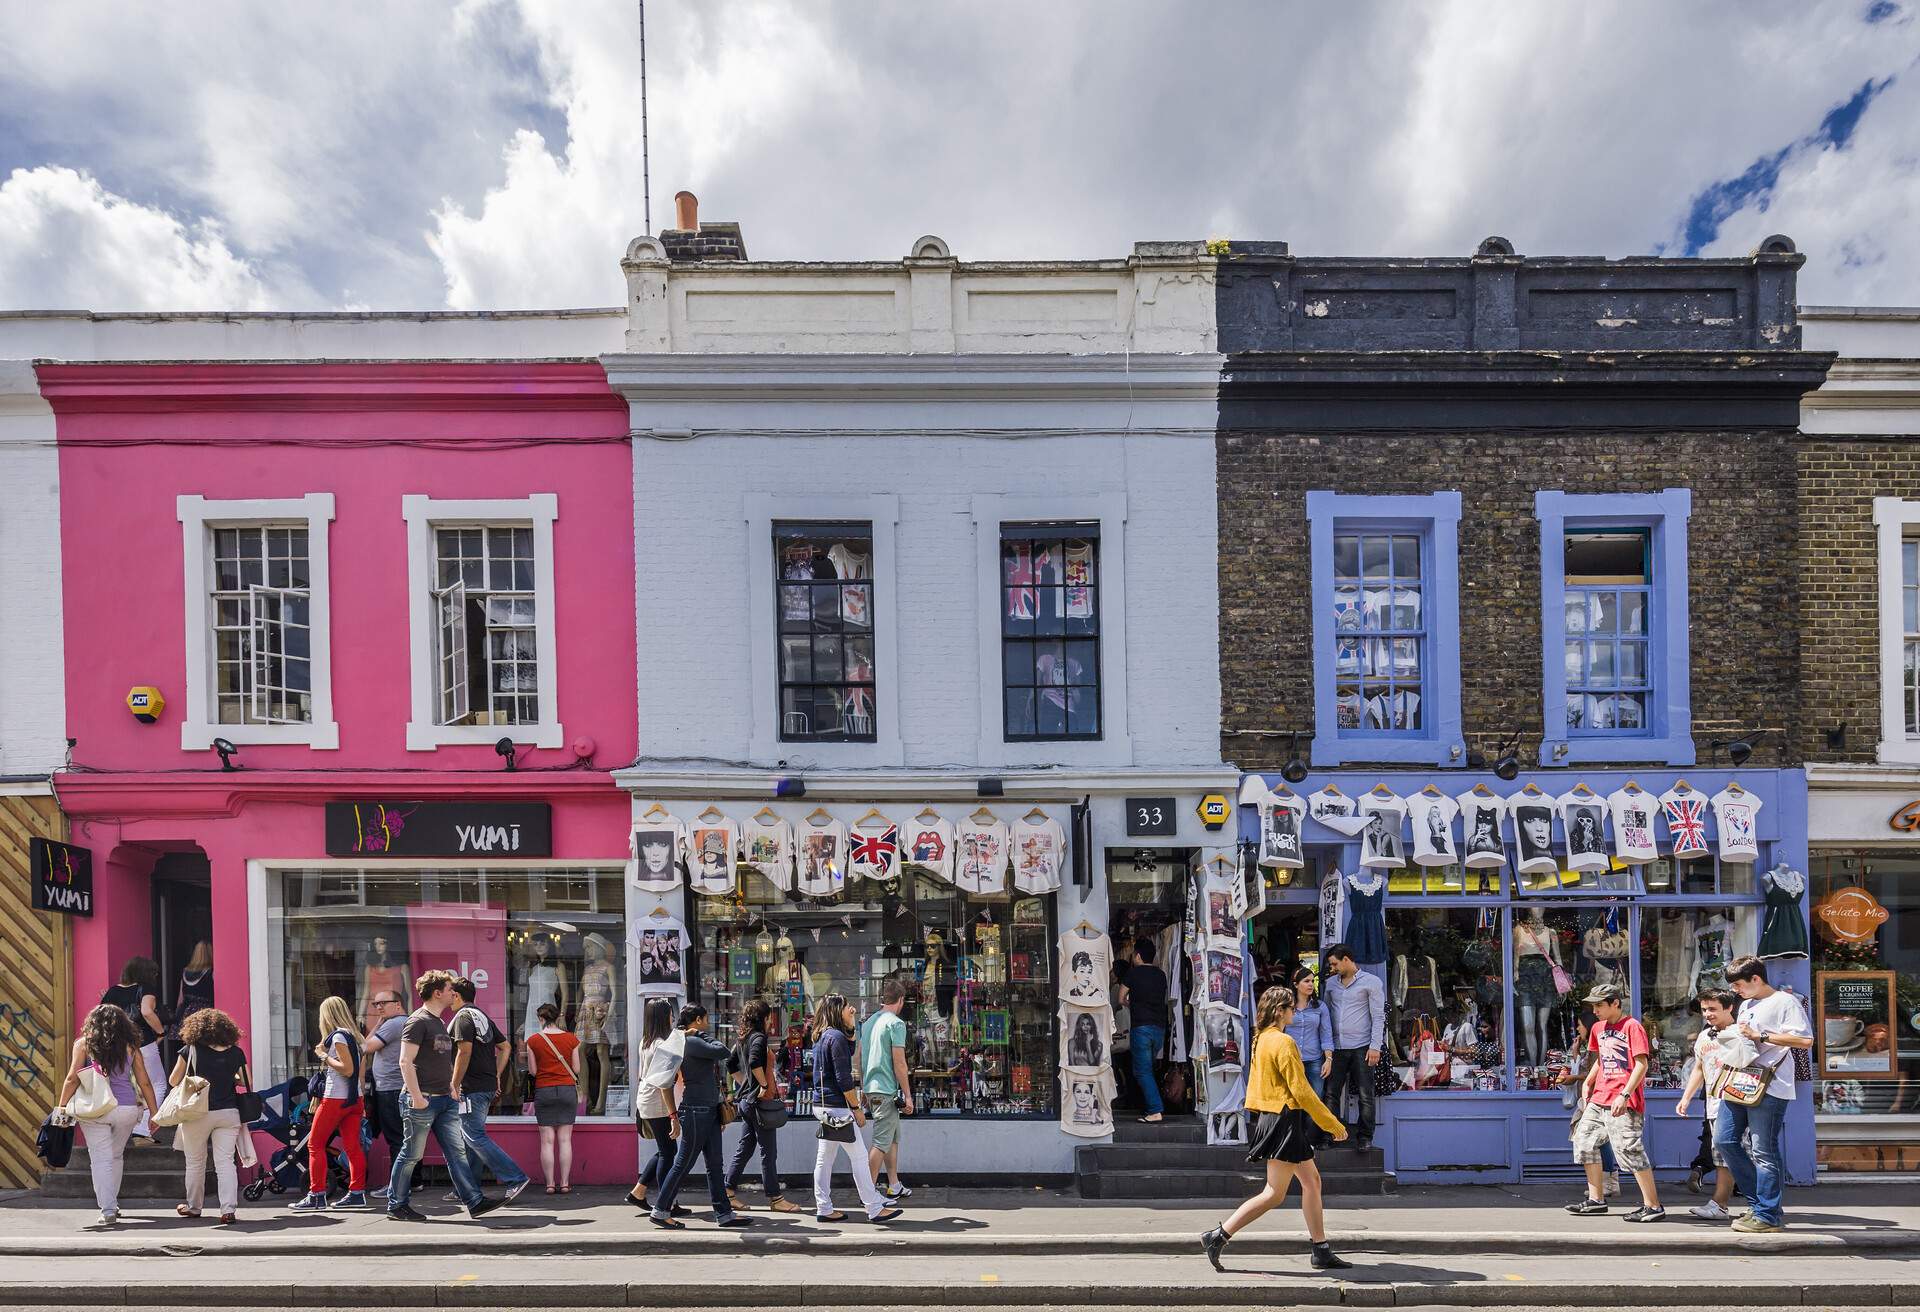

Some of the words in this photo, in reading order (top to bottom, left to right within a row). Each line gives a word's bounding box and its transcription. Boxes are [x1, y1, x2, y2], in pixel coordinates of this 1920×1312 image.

[132, 696, 148, 704] ADT
[1207, 805, 1223, 814] ADT
[1137, 807, 1163, 826] 33
[1269, 832, 1295, 843] FUCK
[1821, 905, 1861, 917] Gelato
[1865, 908, 1885, 918] Mio
